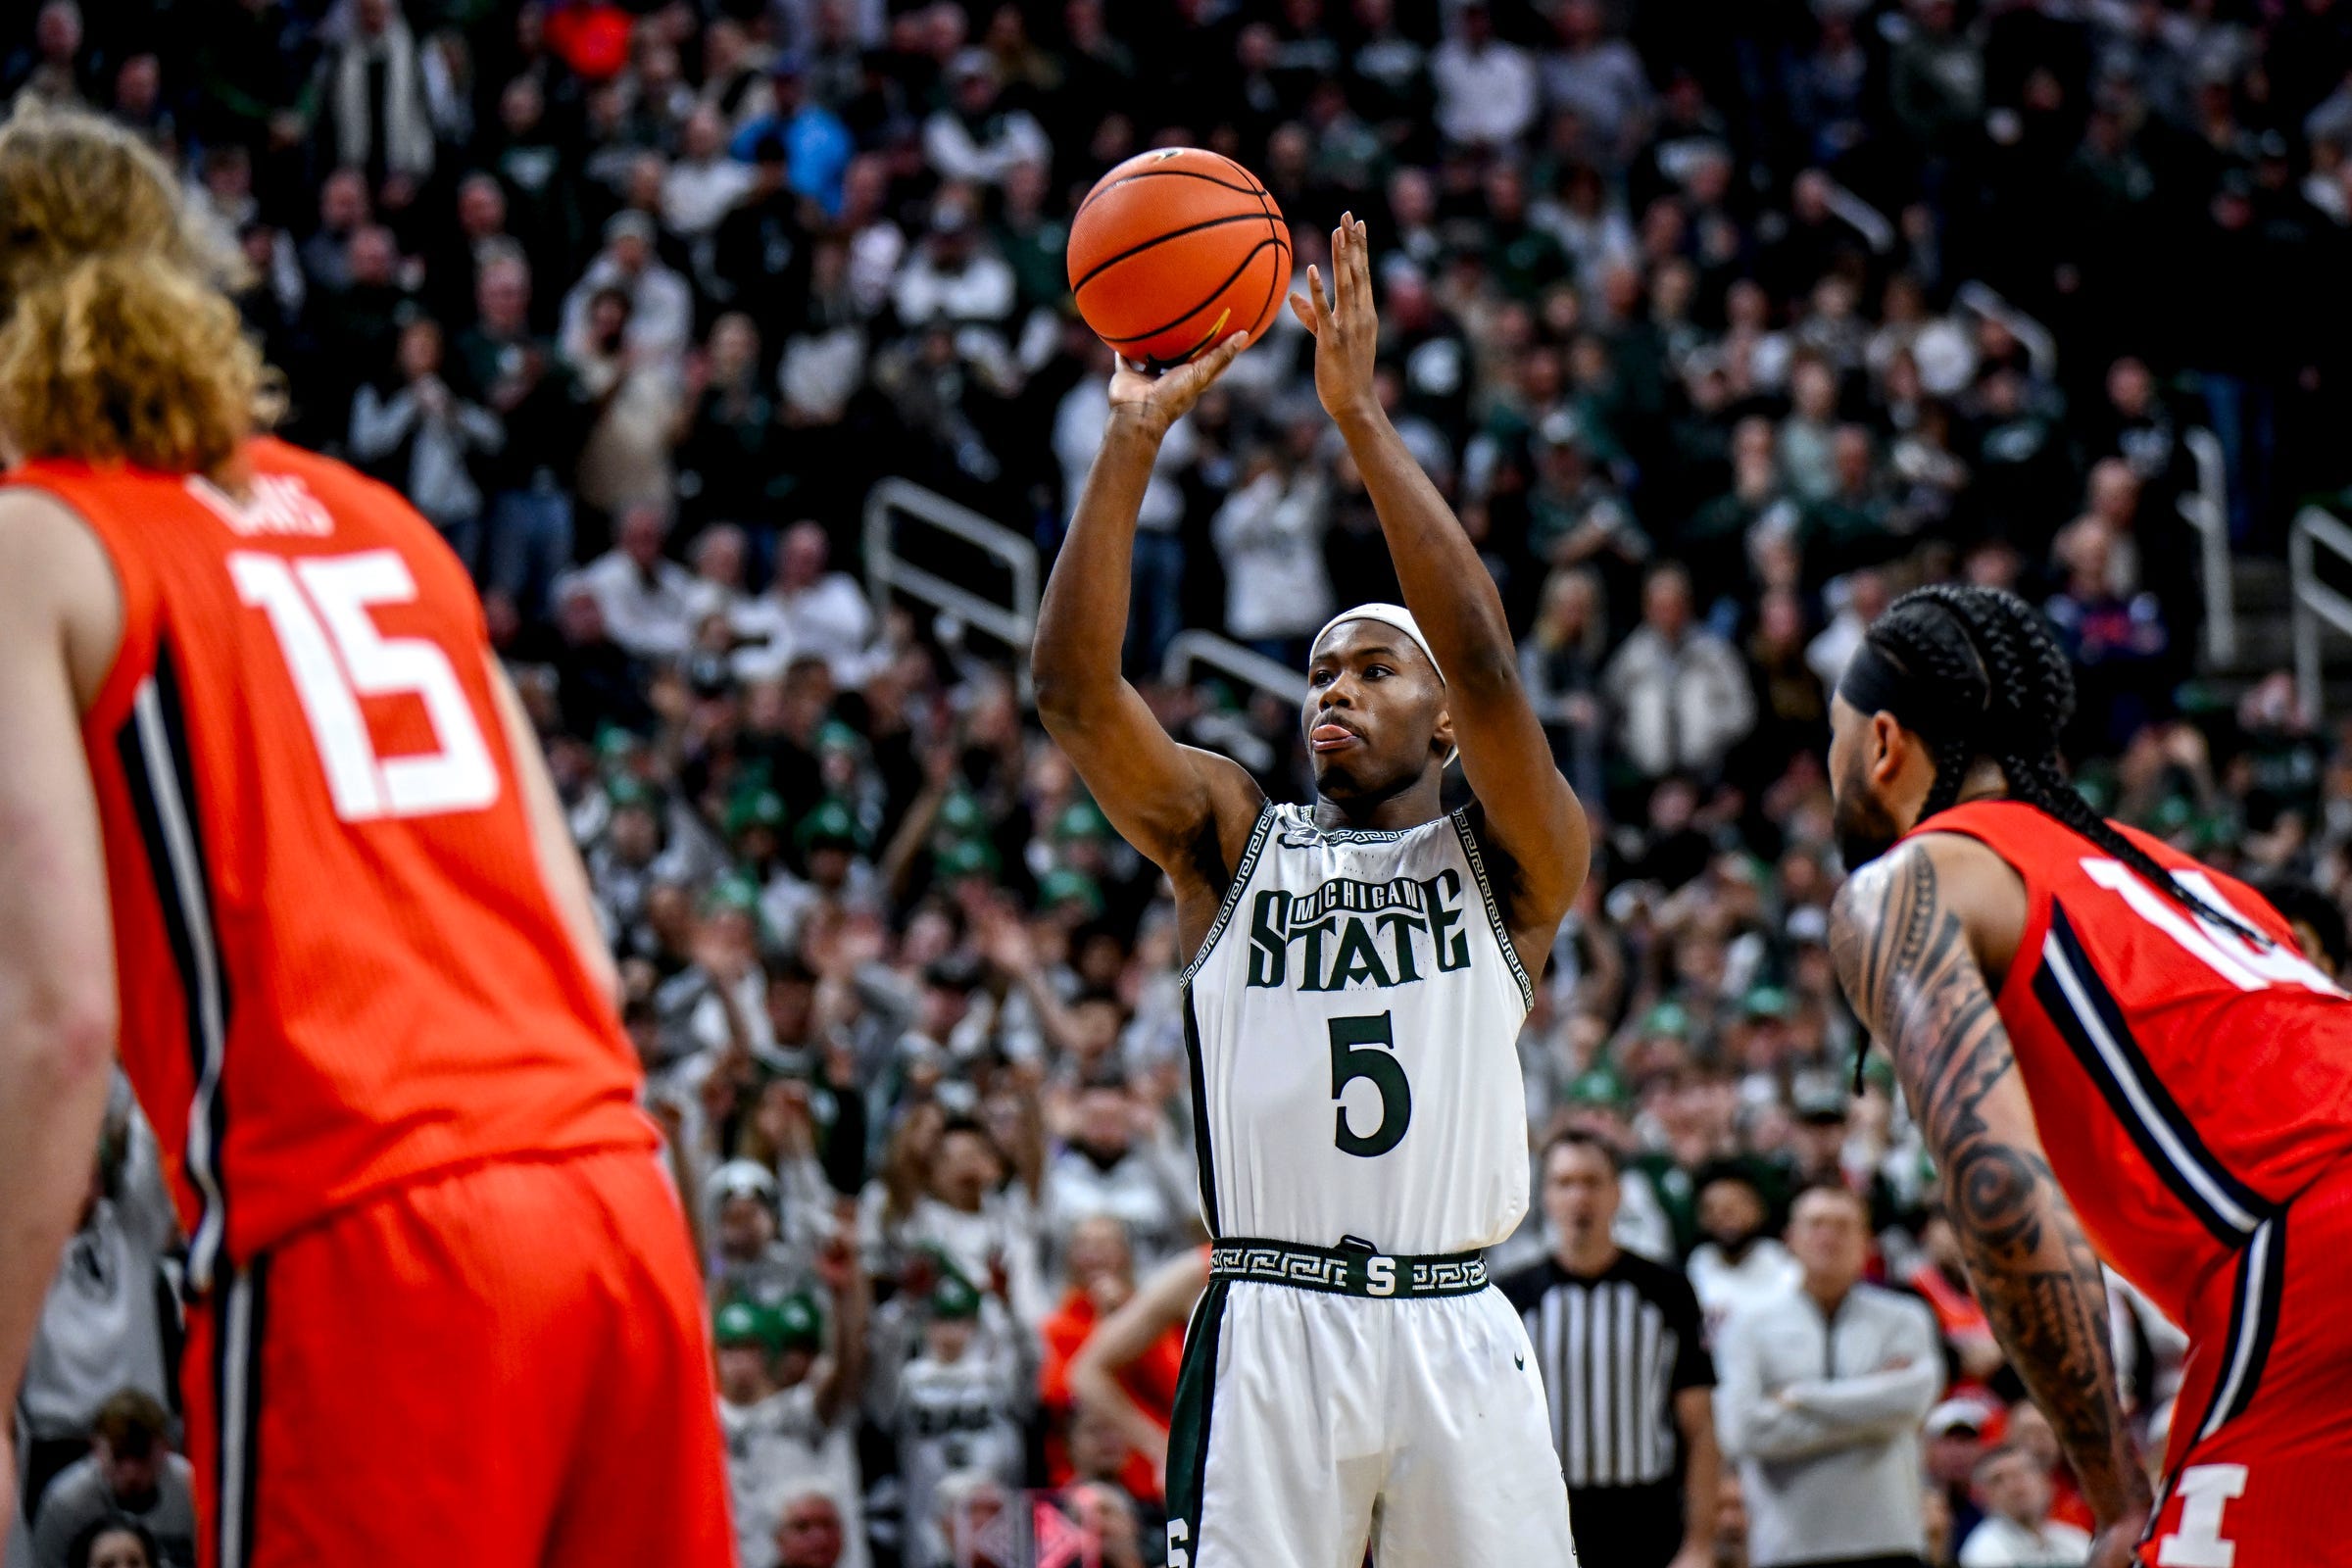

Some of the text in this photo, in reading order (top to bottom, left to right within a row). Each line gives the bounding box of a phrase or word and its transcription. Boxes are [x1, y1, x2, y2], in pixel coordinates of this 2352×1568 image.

[226, 549, 501, 822] 15
[1246, 867, 1472, 992] STATE
[1295, 880, 1419, 922] MICHIGAN
[1328, 1009, 1412, 1157] 5
[1366, 1256, 1396, 1296] S
